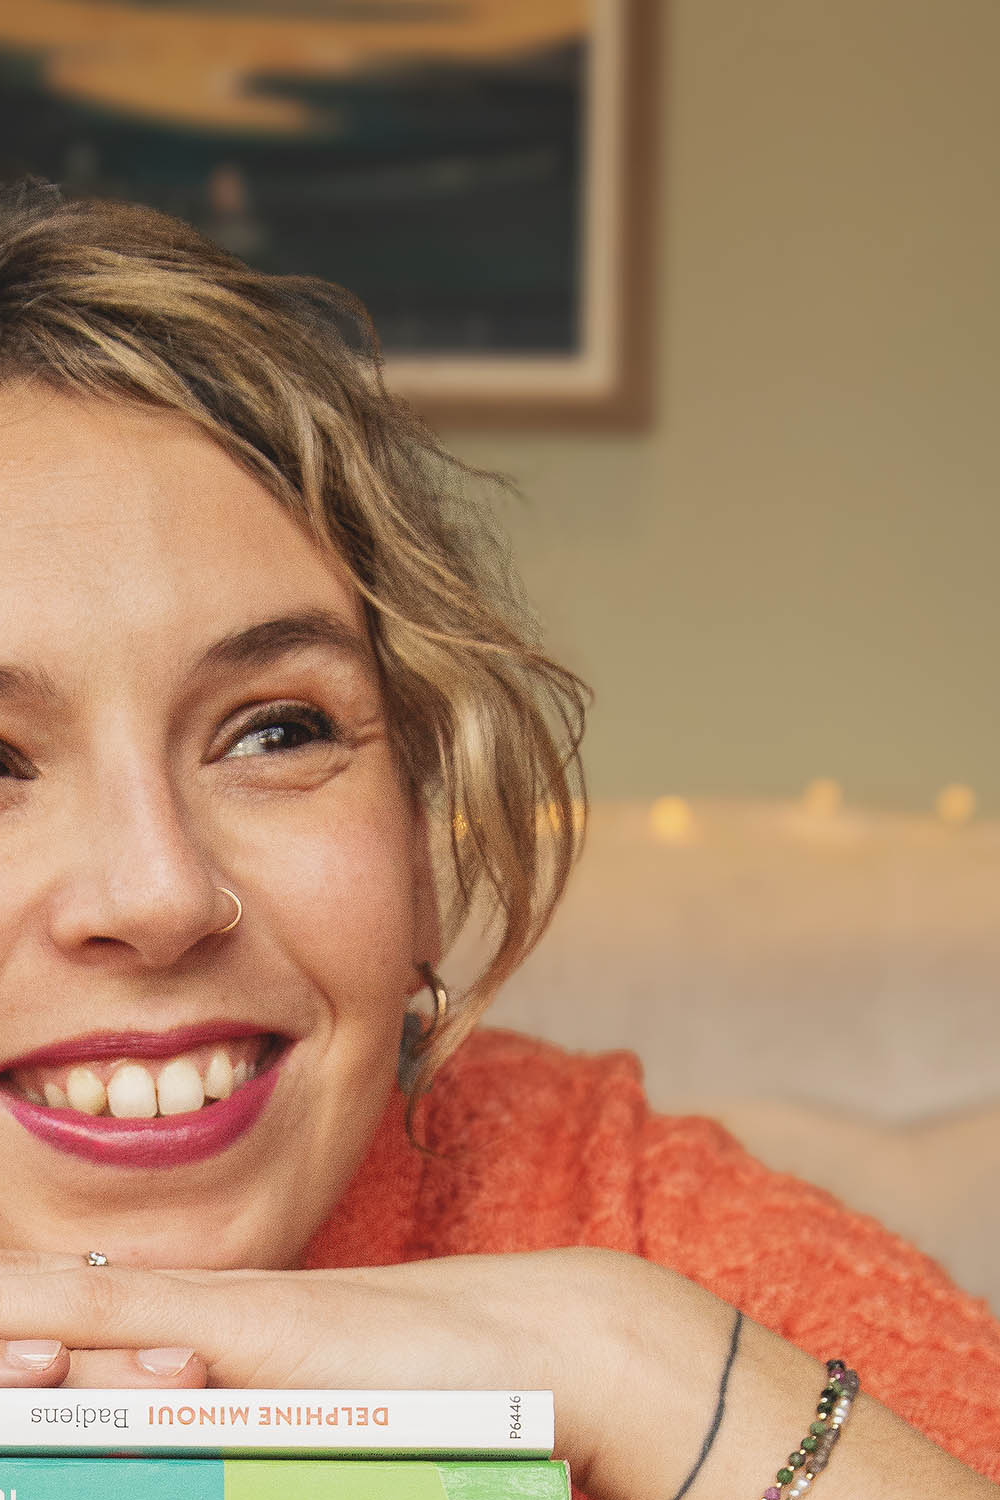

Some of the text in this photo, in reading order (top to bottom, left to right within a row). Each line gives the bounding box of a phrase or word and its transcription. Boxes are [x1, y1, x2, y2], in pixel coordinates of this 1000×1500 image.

[30, 1406, 130, 1429] Badjens
[147, 1405, 389, 1427] DELPHINE MINOUI
[509, 1396, 523, 1440] P6446
